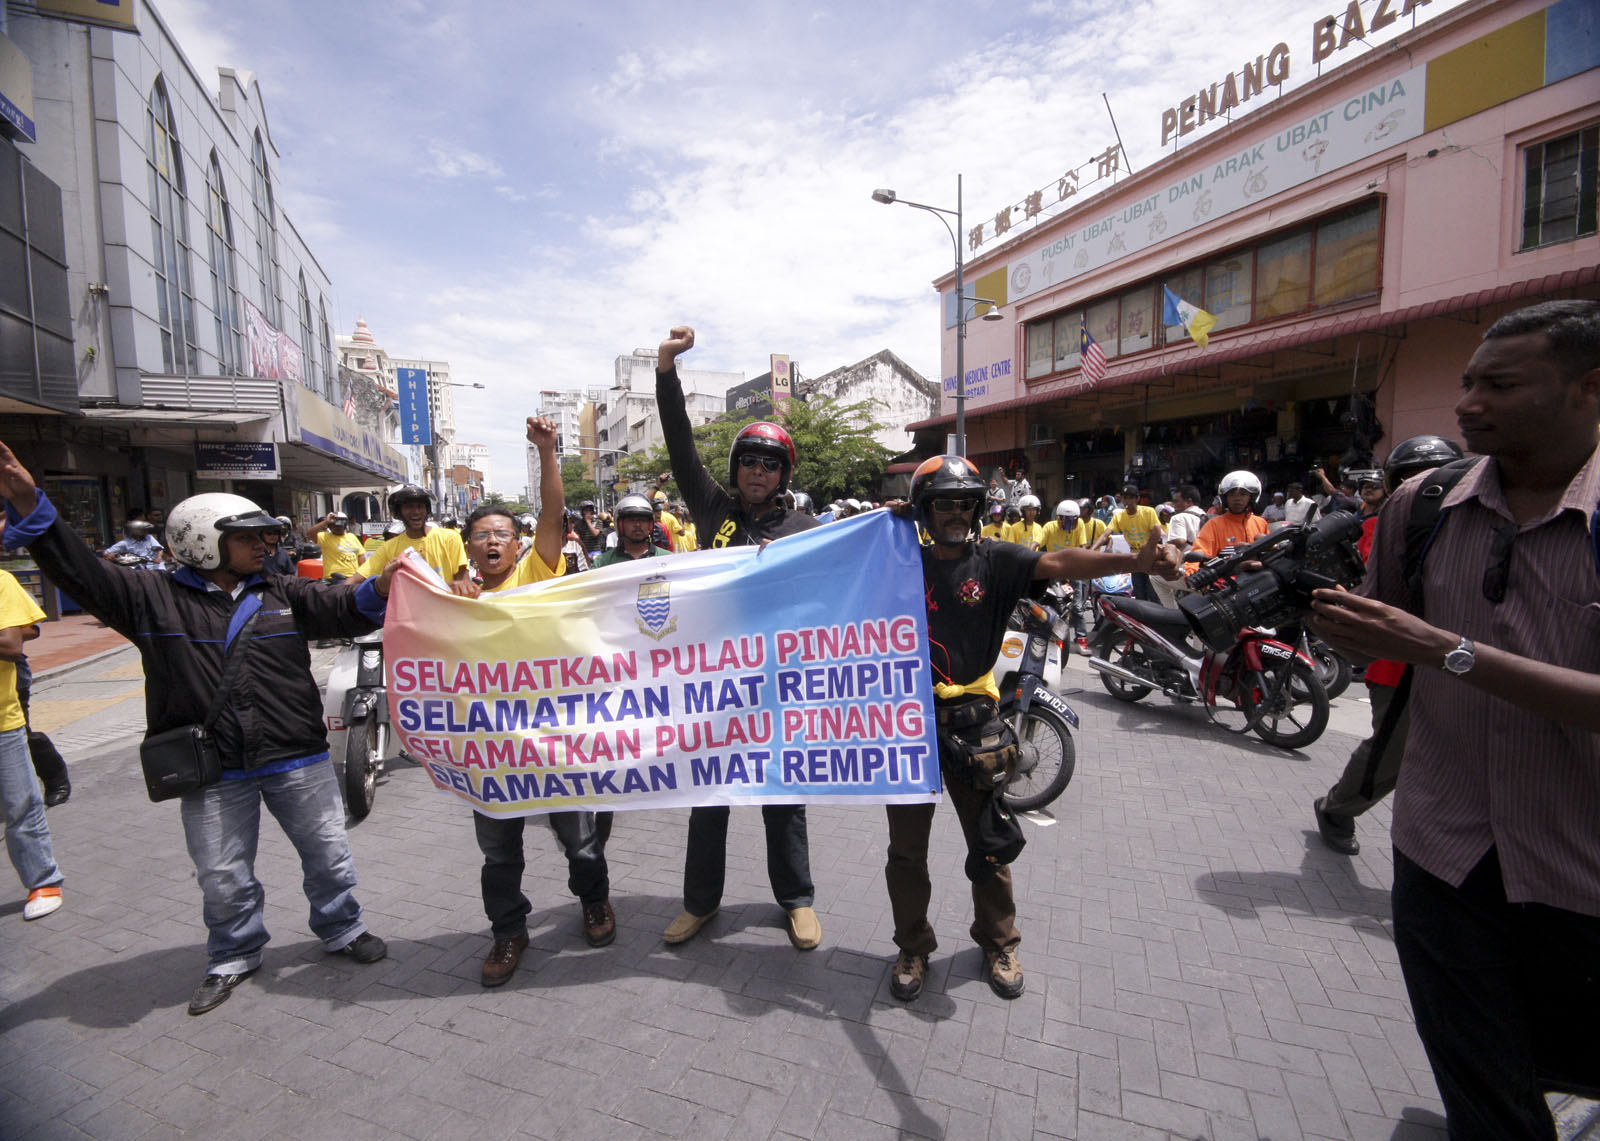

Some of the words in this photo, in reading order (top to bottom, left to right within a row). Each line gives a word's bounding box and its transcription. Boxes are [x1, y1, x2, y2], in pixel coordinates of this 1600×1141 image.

[1161, 42, 1291, 147] PENANG
[1042, 234, 1077, 262] PUSAT
[1083, 194, 1161, 243] UBAT-UBAT
[1168, 174, 1204, 204] DAN
[1212, 143, 1265, 184] ARAK
[1276, 110, 1334, 152] UBAT
[1343, 79, 1407, 122] CINA
[407, 370, 420, 443] PHILIPS
[775, 377, 789, 387] LG
[964, 365, 989, 386] MEDICINE
[991, 358, 1012, 379] CENTRE
[395, 650, 638, 694] SELAMATKAN
[650, 635, 764, 678] PULAU
[776, 618, 916, 664] PINANG
[399, 685, 670, 733] SELAMATKAN
[684, 675, 765, 715] MAT
[778, 659, 920, 702] REMPIT
[408, 727, 641, 770] SELAMATKAN
[656, 711, 772, 757] PULAU
[784, 702, 923, 742] PINANG
[429, 761, 678, 803] SELAMATKAN
[690, 751, 771, 786] MAT
[782, 745, 927, 784] REMPIT
